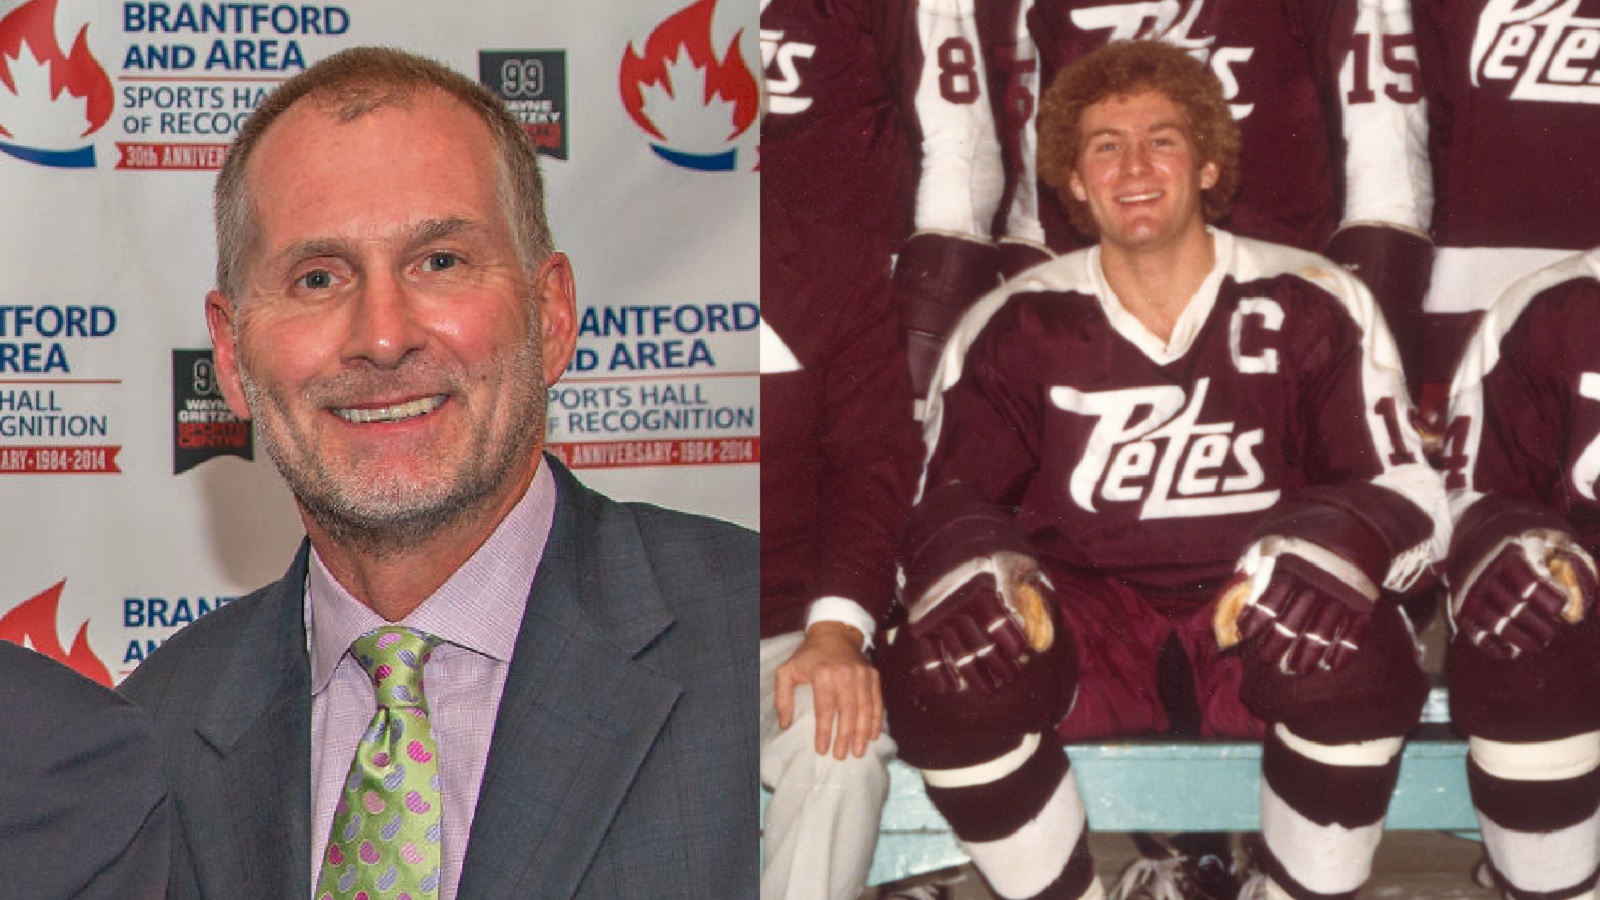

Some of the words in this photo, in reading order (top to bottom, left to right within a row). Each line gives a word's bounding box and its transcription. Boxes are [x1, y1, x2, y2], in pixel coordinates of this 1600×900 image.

[123, 3, 349, 34] BRANTFORD
[123, 45, 195, 69] AND
[204, 40, 305, 70] AREA
[937, 36, 980, 105] 8
[1347, 33, 1424, 105] 15
[501, 59, 543, 96] 99
[123, 86, 224, 108] SPORTS
[232, 87, 266, 108] HA
[123, 115, 152, 134] OF
[0, 304, 117, 337] TFORD
[578, 302, 760, 337] ANTFORD
[1229, 297, 1285, 374] C
[0, 342, 71, 373] REA
[608, 338, 716, 371] AREA
[0, 390, 61, 411] HALL
[548, 385, 632, 410] PORTS
[640, 384, 709, 406] HALL
[0, 415, 107, 437] GNITION
[569, 406, 755, 433] RECOGNITION
[0, 450, 27, 470] ARY
[1050, 377, 1280, 520] Petes
